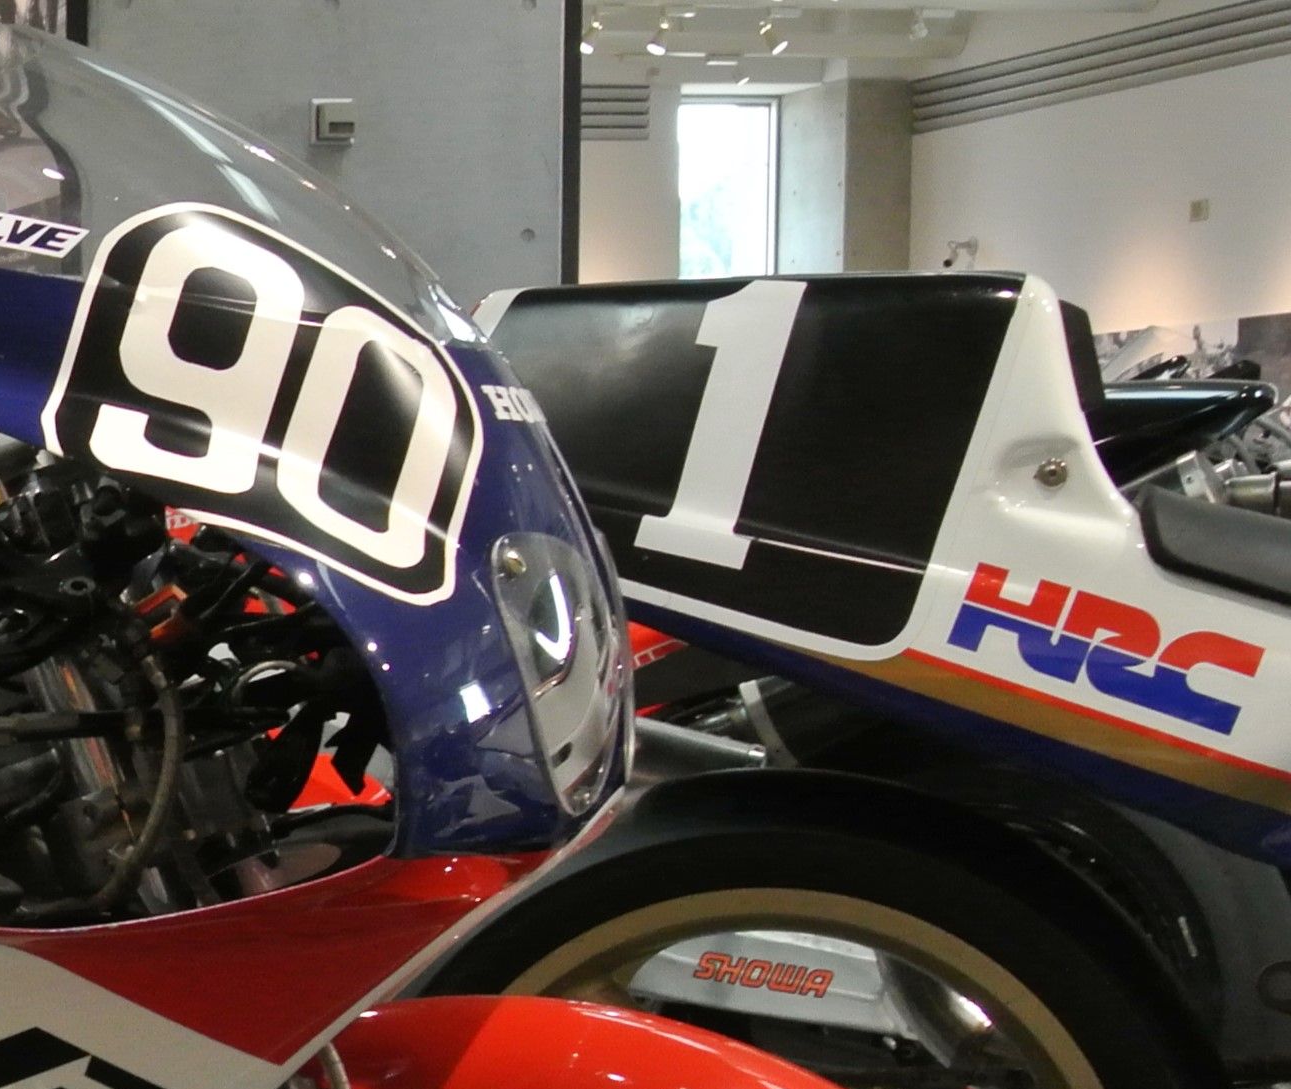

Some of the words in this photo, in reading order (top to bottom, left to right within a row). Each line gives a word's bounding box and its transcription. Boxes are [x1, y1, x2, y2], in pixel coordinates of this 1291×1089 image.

[90, 214, 457, 569] 90
[633, 279, 807, 570] 1
[946, 562, 1265, 736] HRC
[693, 951, 834, 998] SHOWA
